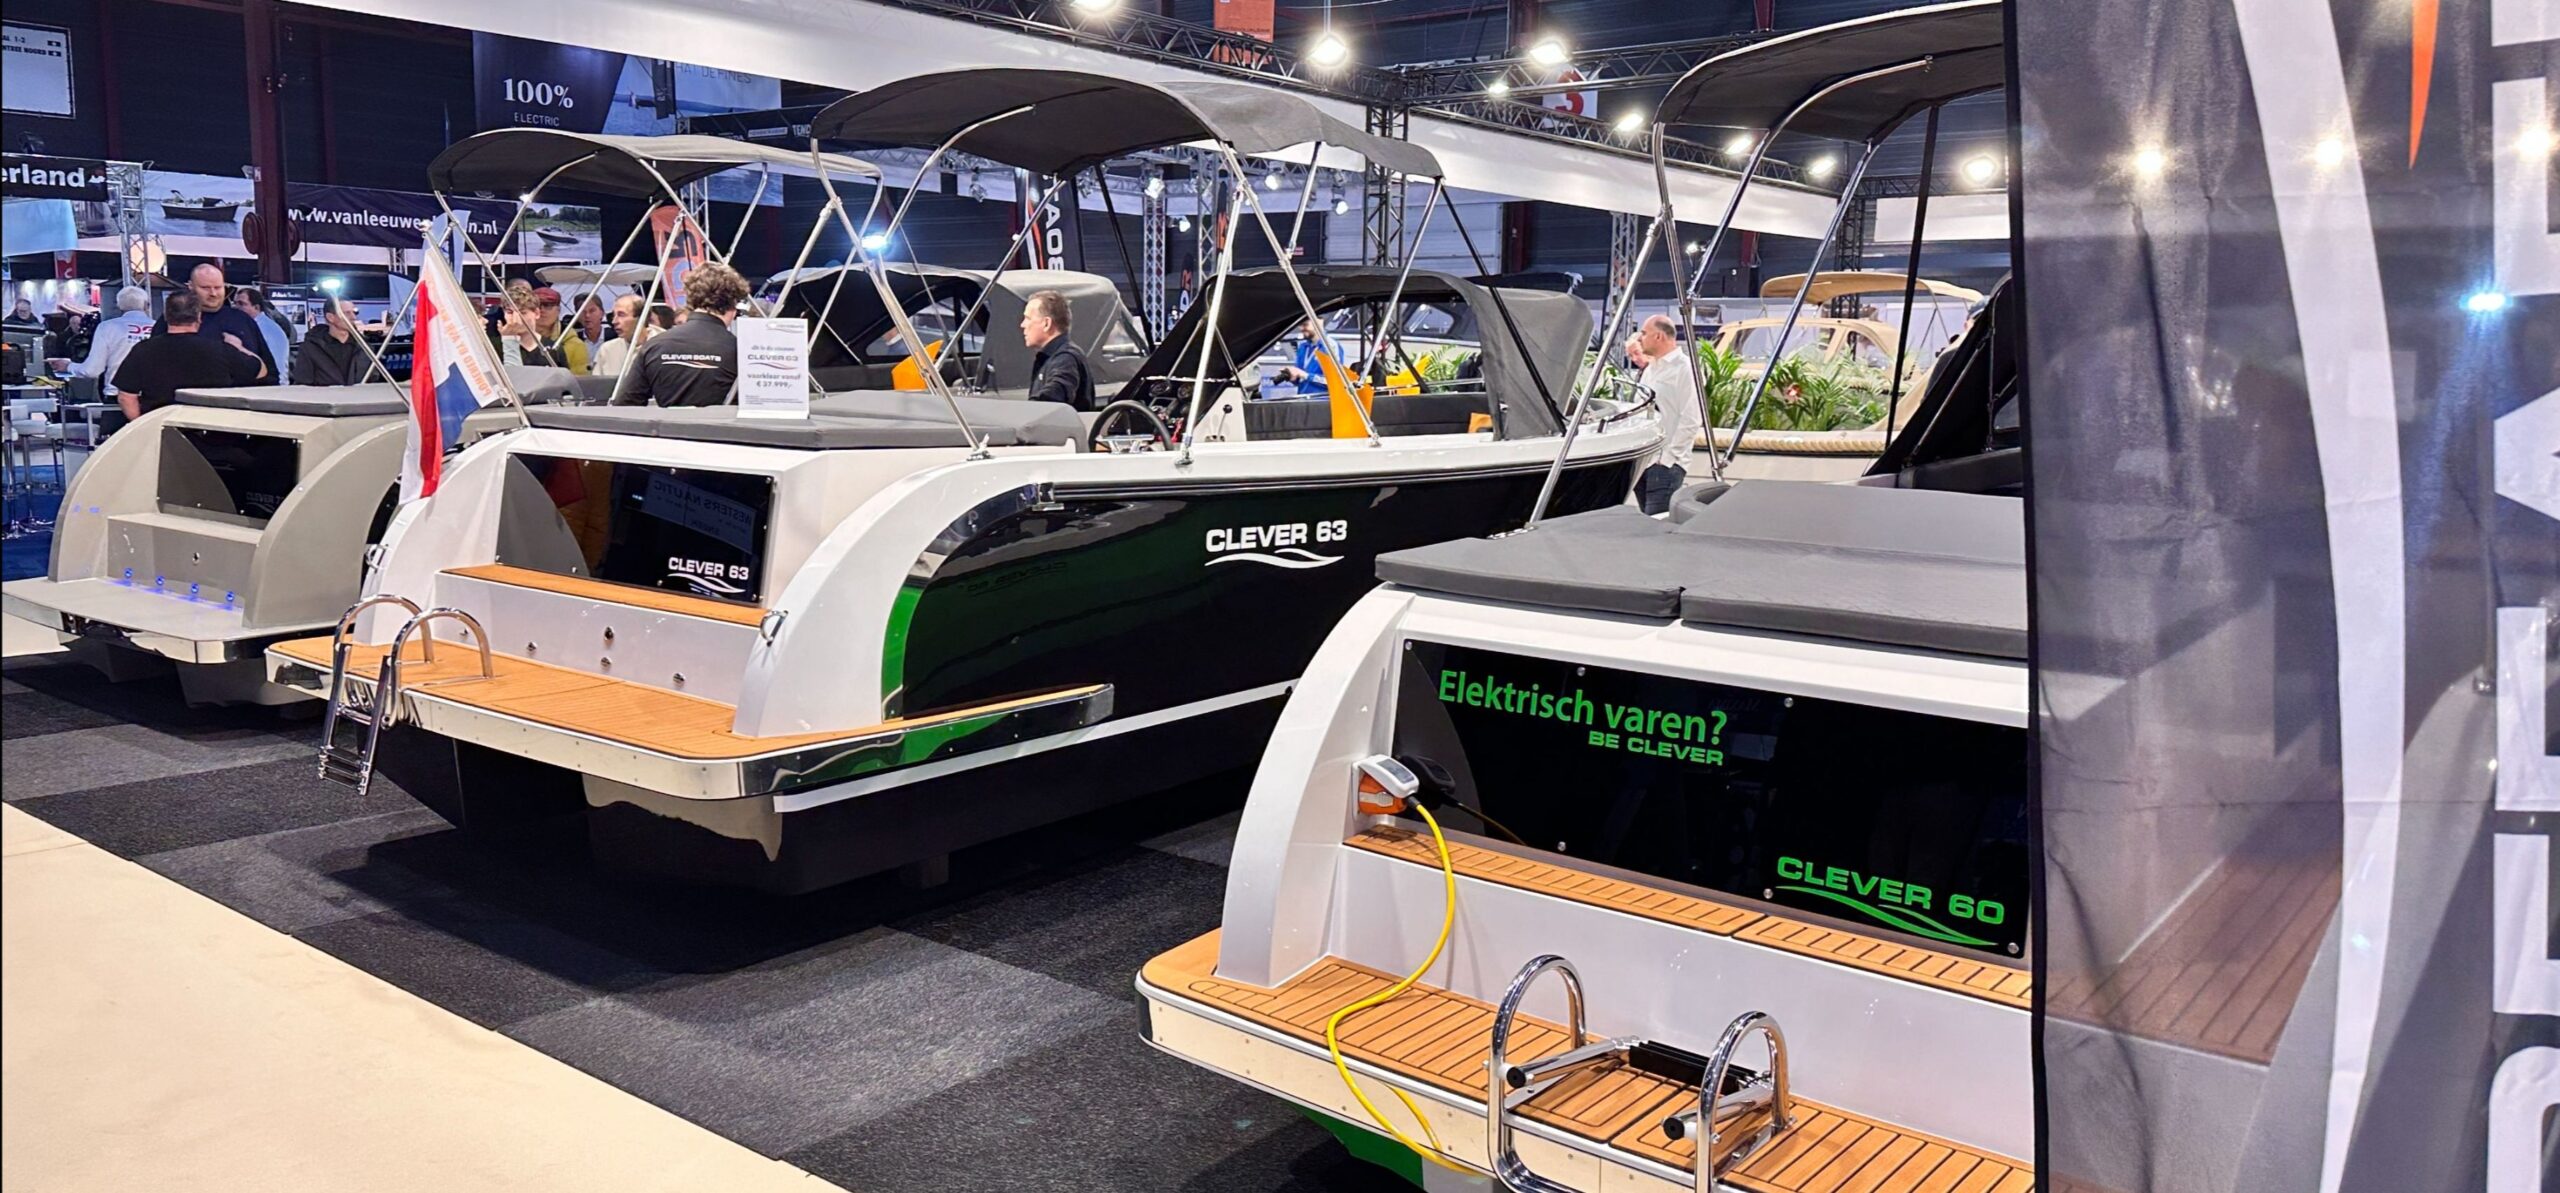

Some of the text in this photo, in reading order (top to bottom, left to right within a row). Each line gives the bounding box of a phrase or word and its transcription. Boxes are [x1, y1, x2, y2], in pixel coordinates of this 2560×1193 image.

[2, 44, 22, 53] NTREE
[503, 78, 574, 109] 100%
[514, 111, 560, 127] ELECTRIC
[661, 353, 722, 362] CLEVER BOATS
[1206, 519, 1348, 553] CLEVER 63
[668, 556, 750, 581] CLEVER 63
[1439, 669, 1728, 746] Elektrisch varen?
[1588, 730, 1724, 767] BE CLEVER
[1776, 855, 2005, 926] CLEVER 60
